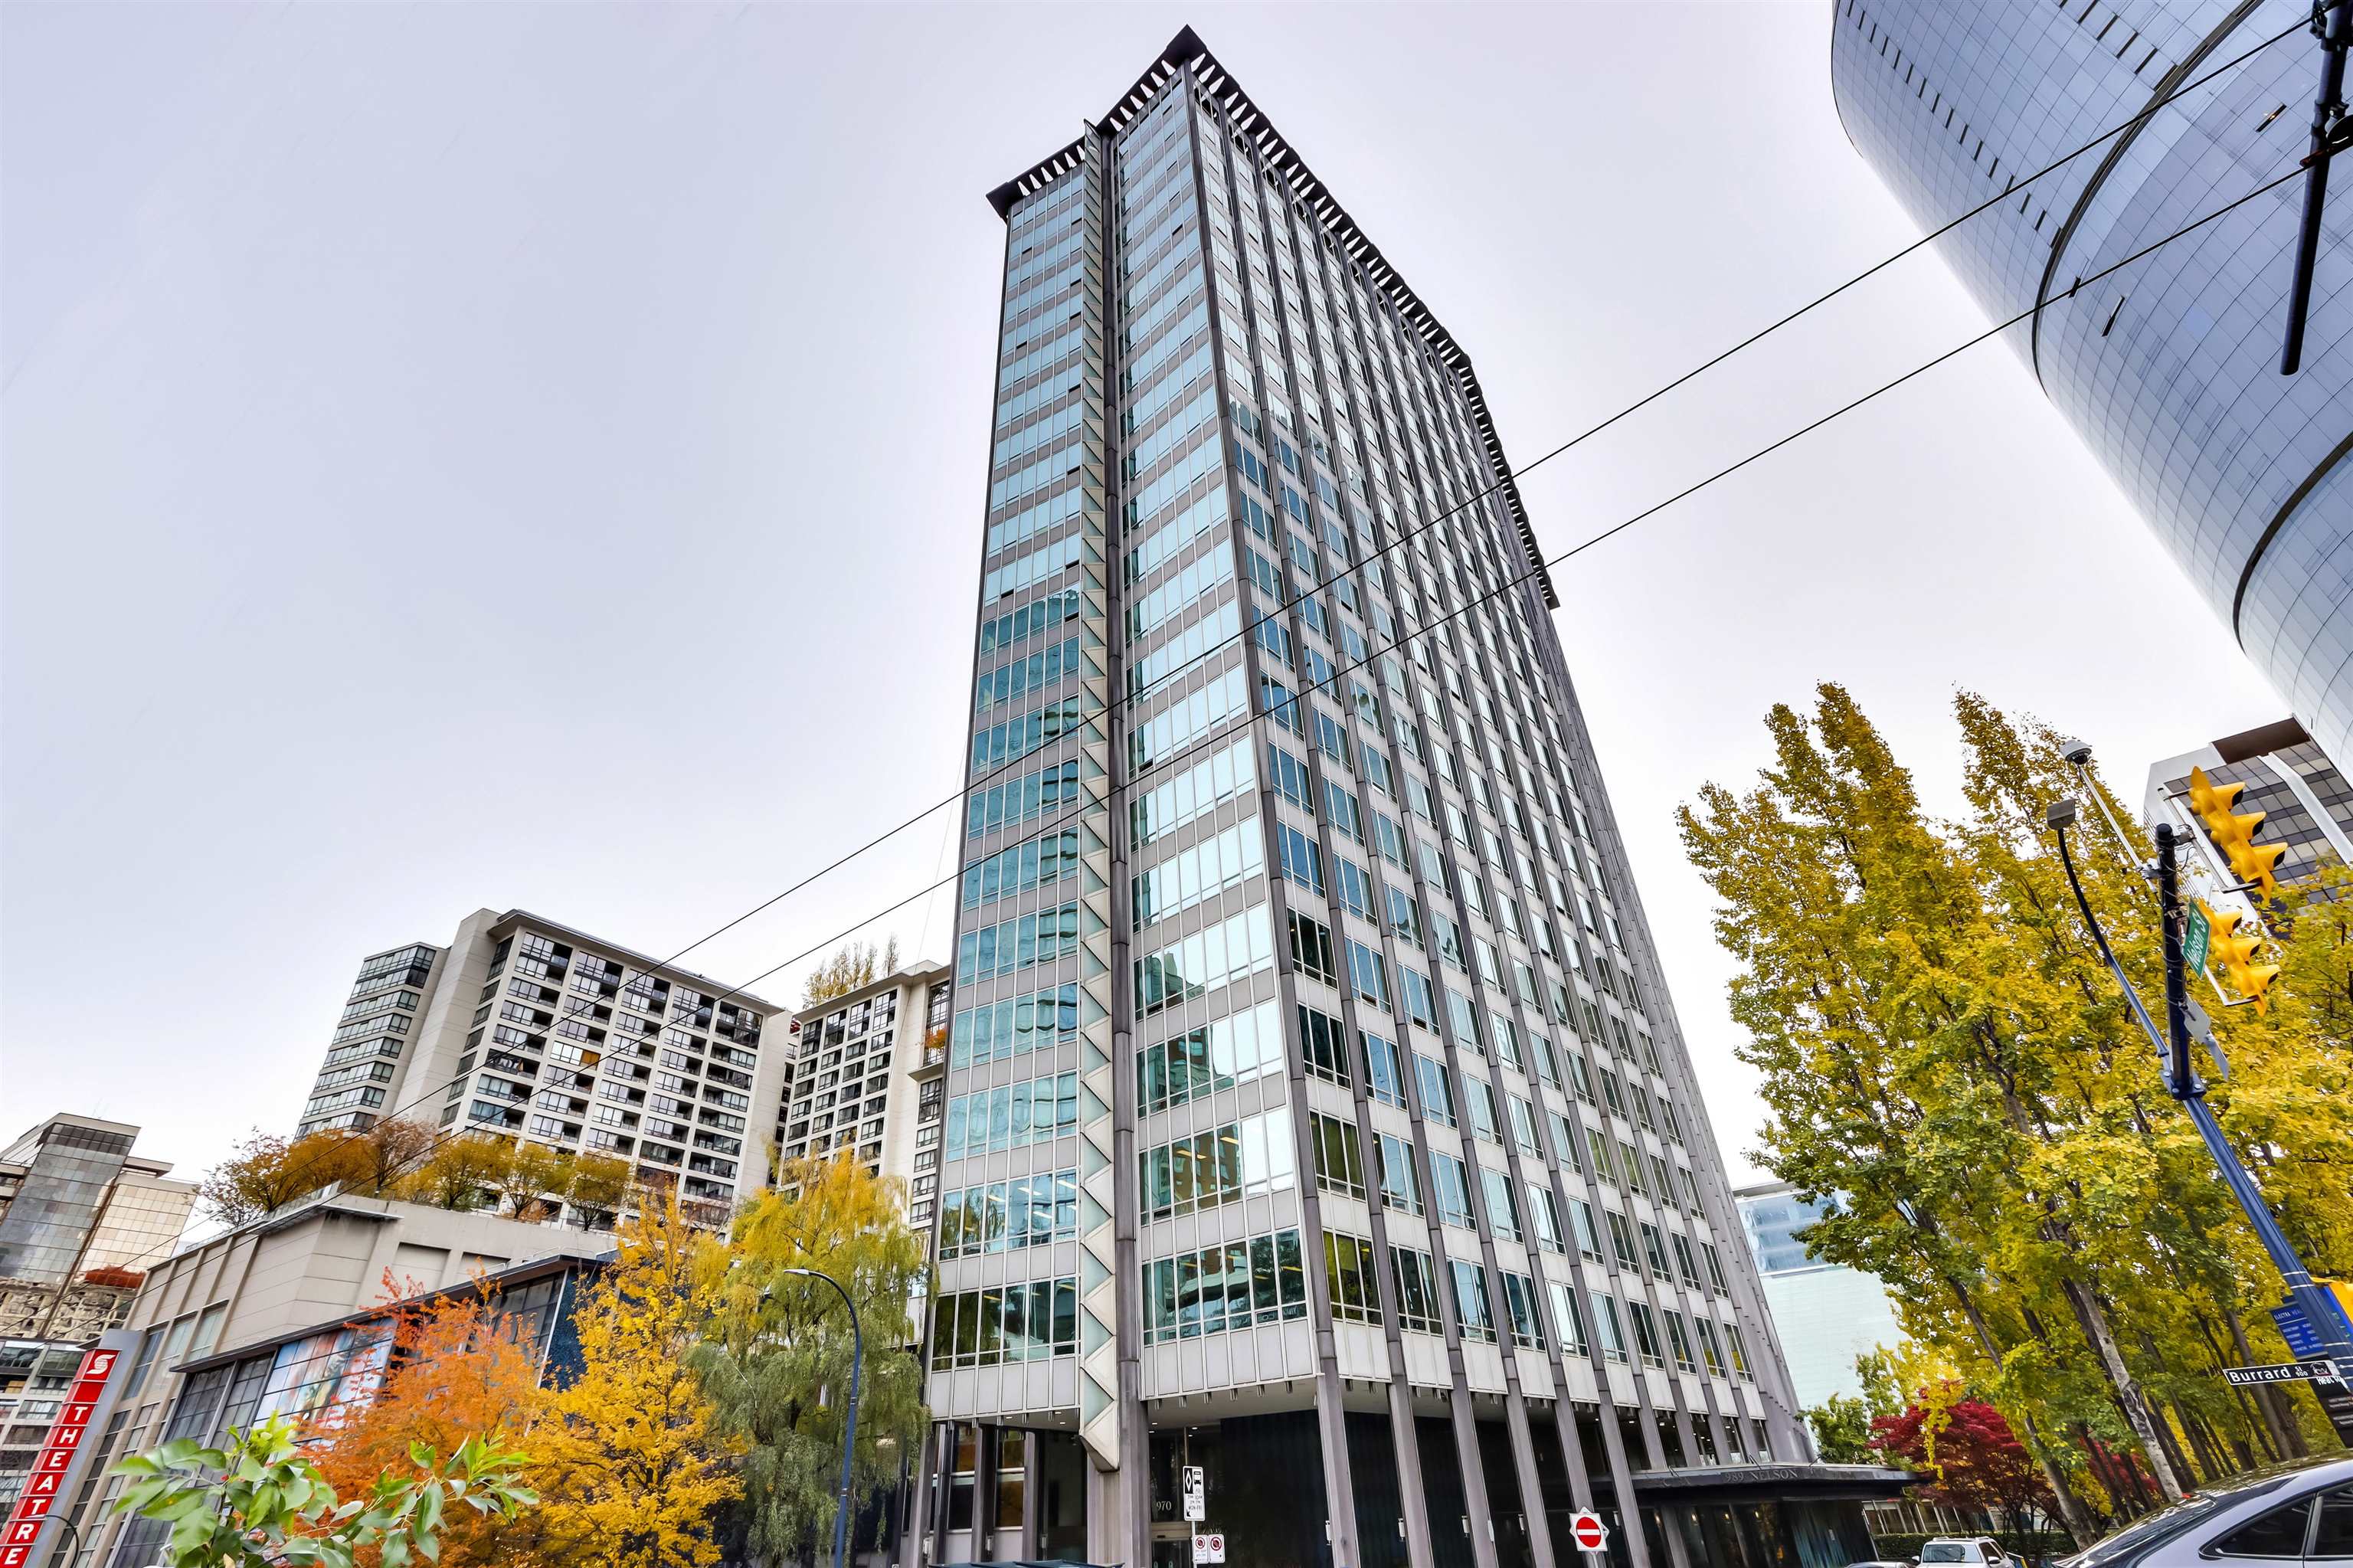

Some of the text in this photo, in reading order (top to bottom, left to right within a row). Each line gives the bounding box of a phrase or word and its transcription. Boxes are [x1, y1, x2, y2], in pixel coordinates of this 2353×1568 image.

[2187, 928, 2204, 971] Nelson
[2230, 1367, 2292, 1382] Burrard
[1726, 1468, 1798, 1482] 989 NELSON
[5, 1406, 88, 1565] THEATRE
[1156, 1501, 1172, 1511] 970
